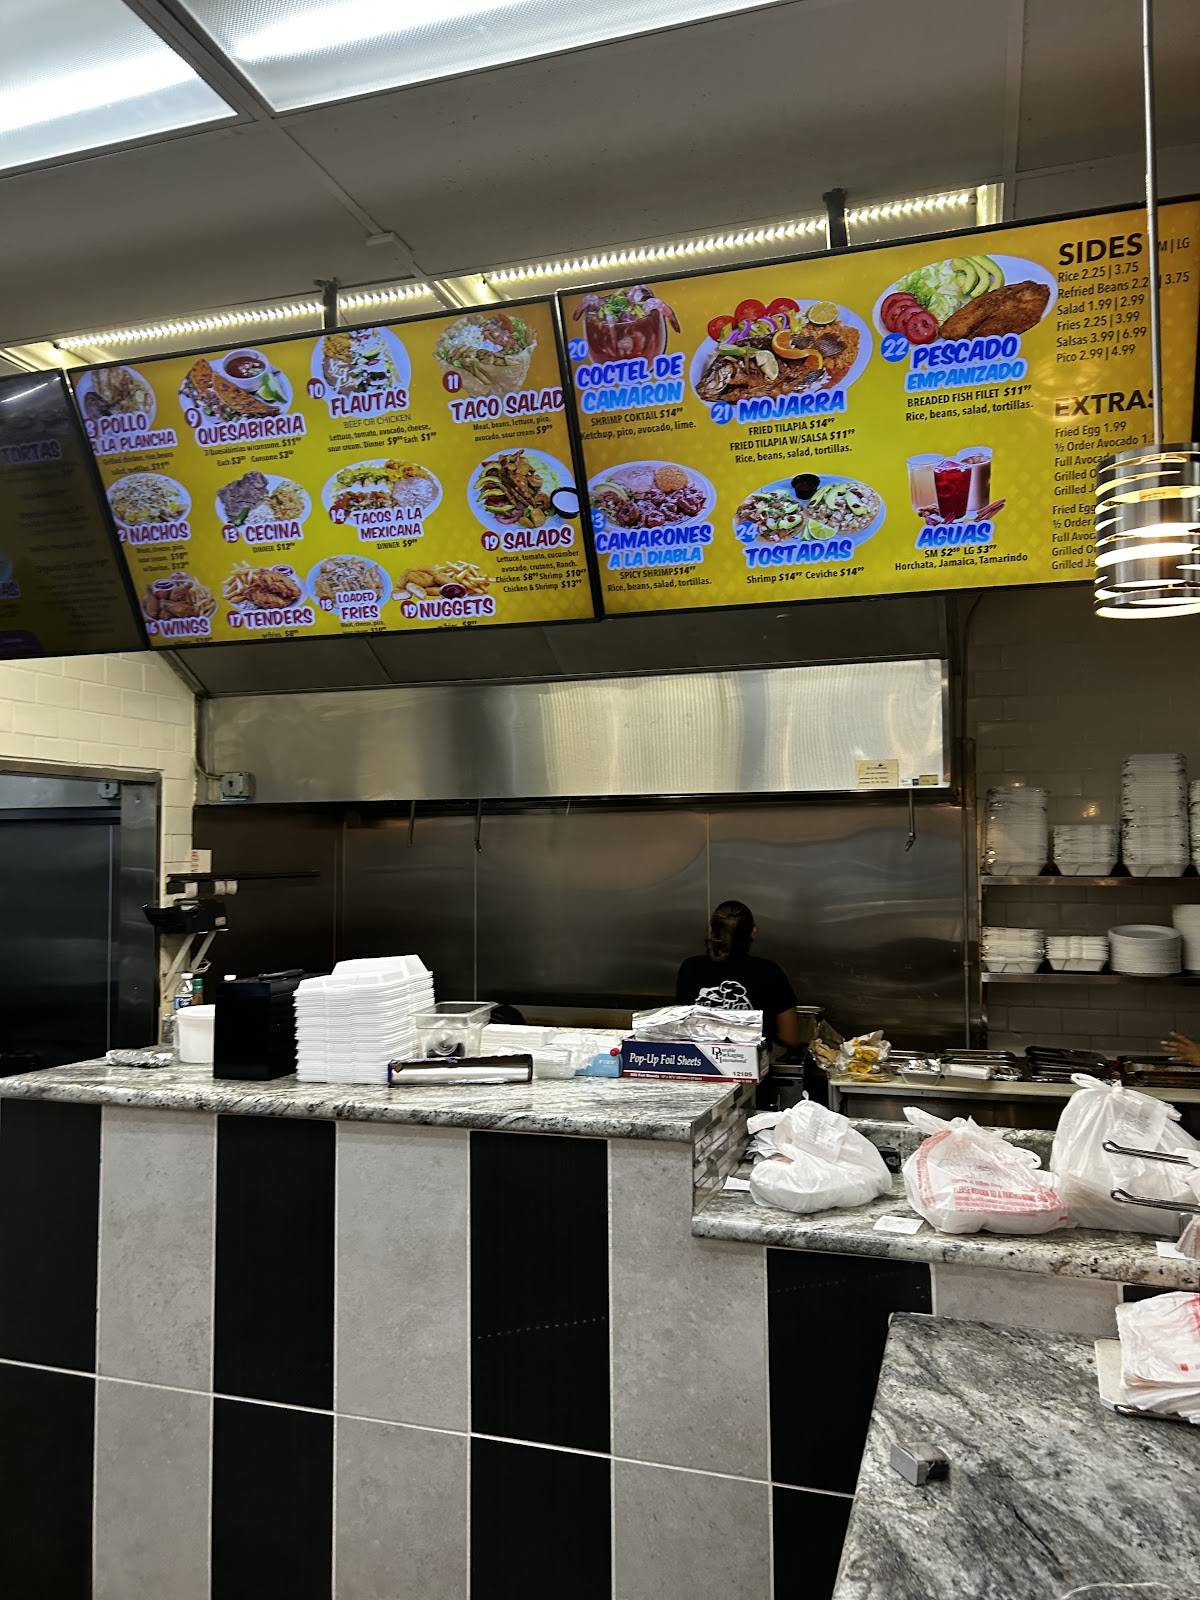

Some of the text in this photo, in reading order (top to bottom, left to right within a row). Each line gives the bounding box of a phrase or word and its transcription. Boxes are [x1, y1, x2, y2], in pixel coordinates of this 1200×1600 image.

[1058, 232, 1143, 266] SIDES
[1176, 237, 1190, 249] LG
[1058, 261, 1139, 282] Rice 2.25 3.75
[1058, 272, 1190, 299] Refried Beans 3.75
[1058, 294, 1145, 315] Salad 1.99 2.99
[1057, 311, 1140, 331] Fries 2.25 3.99
[1057, 327, 1147, 347] Salsas 3.99 6.99
[568, 341, 588, 359] 20
[883, 338, 907, 357] 22
[913, 336, 1018, 369] PESCADO
[1057, 344, 1136, 363] Pico 2.99 4.99
[577, 355, 683, 388] COCTEL DE
[907, 361, 1024, 391] EMPANIZADO
[308, 382, 324, 398] 10
[583, 381, 683, 412] CAMARON
[907, 394, 950, 408] BREADED
[952, 391, 973, 403] FISH
[975, 388, 999, 400] FILET
[331, 389, 407, 415] FLAUTAS
[451, 390, 564, 420] TACO SALAD
[740, 390, 845, 422] MOJARRA
[591, 411, 658, 427] SHRIMP COKTAIL
[713, 404, 729, 421] 21
[905, 400, 1034, 422] Rice, beans, salad, tortillas.
[101, 414, 147, 435] POLLO
[344, 414, 412, 428] BEEF OR CHICKEN
[617, 428, 636, 438] pico,
[638, 423, 673, 434] avocado,
[674, 420, 697, 430] lime.
[748, 425, 773, 436] FRIED
[775, 421, 808, 434] TILAPIA
[1056, 421, 1126, 438] Fried Egg 1.99
[198, 416, 304, 445] QUESABIRRIA
[102, 431, 176, 452] LA PLANCHA
[730, 440, 754, 451] FRIED
[755, 436, 788, 448] TILAPIA
[790, 432, 829, 445] W/SALSA
[1067, 440, 1095, 451] Order
[1097, 434, 1138, 448] Avocado
[735, 443, 853, 464] Rice, beans, salad, tortillas.
[1055, 456, 1072, 467] Full
[1054, 470, 1087, 481] Grilled
[1054, 484, 1087, 496] Grilled
[331, 509, 346, 522] 14
[353, 507, 422, 525] TACOS A LA
[1053, 504, 1096, 515] Fried Egg
[1064, 517, 1091, 527] Order
[129, 522, 189, 544] NACHOS
[245, 522, 302, 542] CECINA
[361, 523, 421, 539] MEXICANA
[504, 527, 572, 549] SALADS
[596, 524, 712, 551] CAMARONES
[736, 523, 758, 540] 24
[917, 522, 992, 548] AGUAS
[1052, 532, 1070, 542] Full
[376, 541, 400, 550] DINNER
[484, 535, 499, 550] 19
[1052, 545, 1084, 557] Grilled
[496, 555, 522, 563] Lettuce,
[547, 549, 580, 558] cucumber
[609, 546, 702, 570] A LA DIABLA
[745, 539, 852, 567] TOSTADAS
[924, 546, 975, 558] SM LG
[501, 565, 529, 573] avocado,
[895, 552, 1028, 571] Horchata, Jamaica, Tamarindo
[1052, 559, 1083, 570] Grilled
[495, 572, 563, 583] Chicken Shrimp
[619, 567, 674, 580] SPICY SHRIMP
[746, 575, 777, 584] Shrimp
[805, 568, 838, 579] Ceviche
[503, 582, 559, 593] Chicken Shrimp
[607, 576, 712, 592] Rice, beans, salad, tortillas.
[338, 591, 374, 602] LOADED
[320, 600, 333, 611] 18
[342, 605, 379, 620] FRIES
[403, 604, 418, 617] 19
[420, 598, 494, 618] NUGGETS
[245, 608, 313, 627] TENDERS
[161, 619, 210, 636] WINGS
[629, 1052, 659, 1067] Pop-Up
[660, 1053, 676, 1066] Foil
[677, 1055, 702, 1067] Sheets
